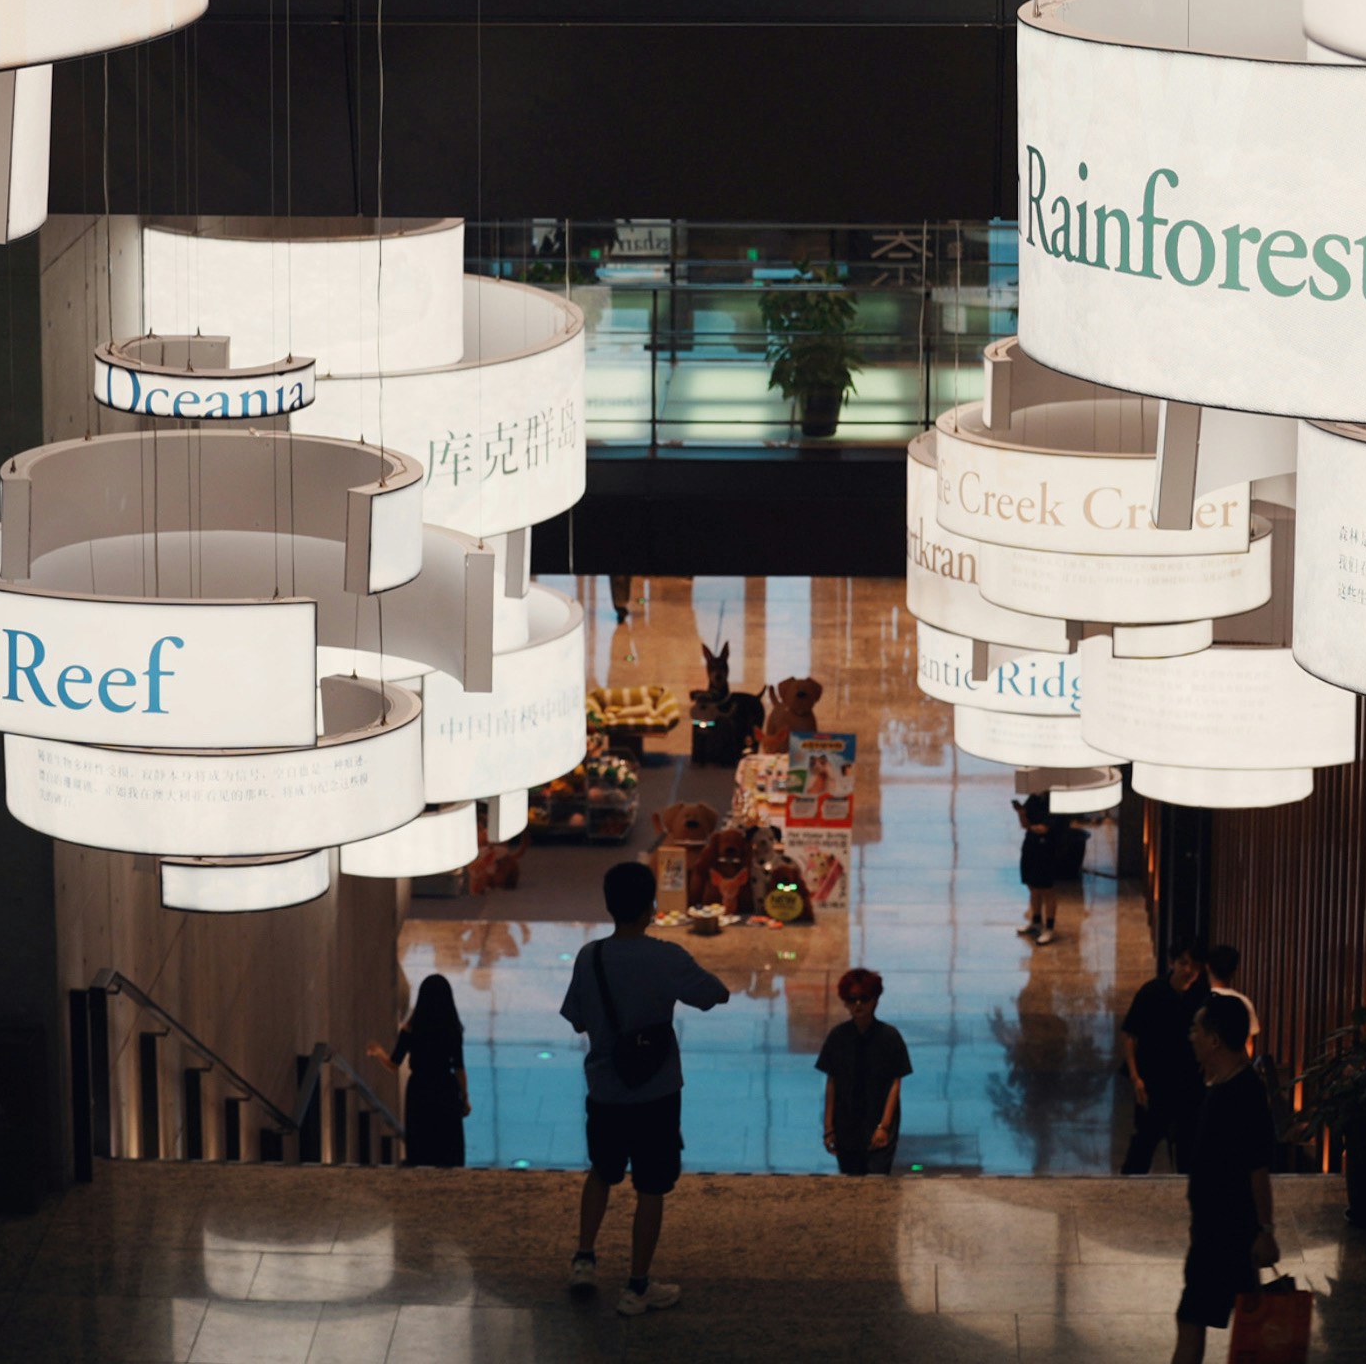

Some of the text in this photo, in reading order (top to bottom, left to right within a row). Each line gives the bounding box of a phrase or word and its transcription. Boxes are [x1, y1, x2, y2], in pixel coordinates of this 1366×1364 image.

[424, 398, 576, 489] 库克群岛
[958, 472, 1065, 527] Creek
[1083, 487, 1239, 530] Crer
[2, 628, 185, 715] Reef
